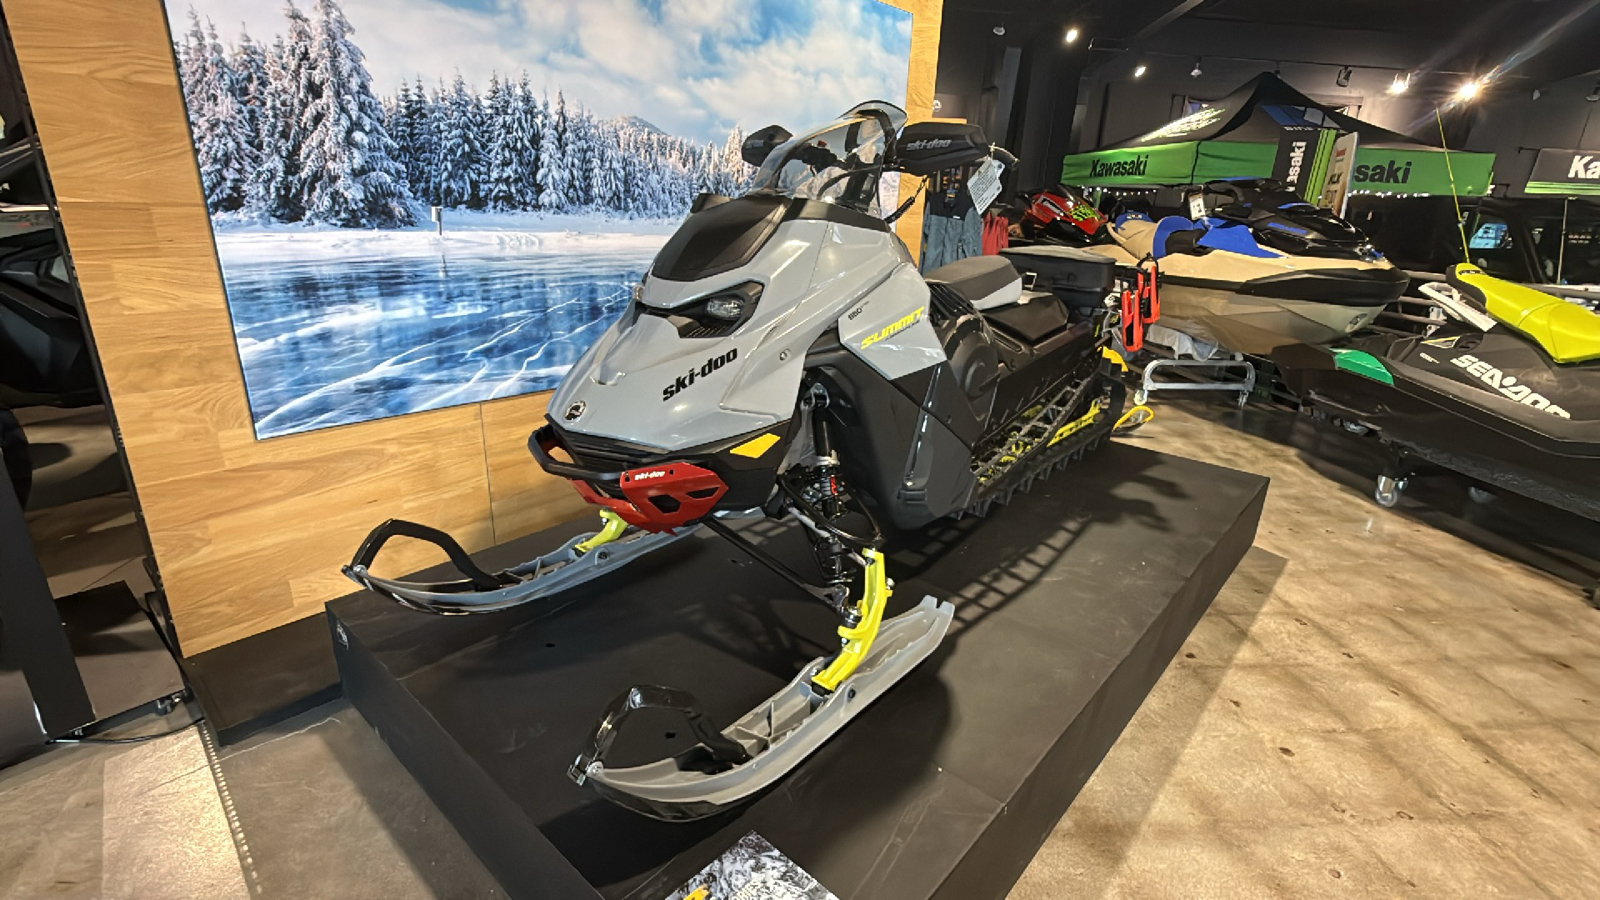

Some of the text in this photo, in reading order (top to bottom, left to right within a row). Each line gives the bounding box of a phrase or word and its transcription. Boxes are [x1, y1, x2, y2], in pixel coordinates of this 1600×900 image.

[1089, 155, 1149, 178] Kawasaki
[1353, 160, 1413, 184] saki
[860, 305, 926, 350] SUMMIT
[662, 347, 738, 402] ski-doo
